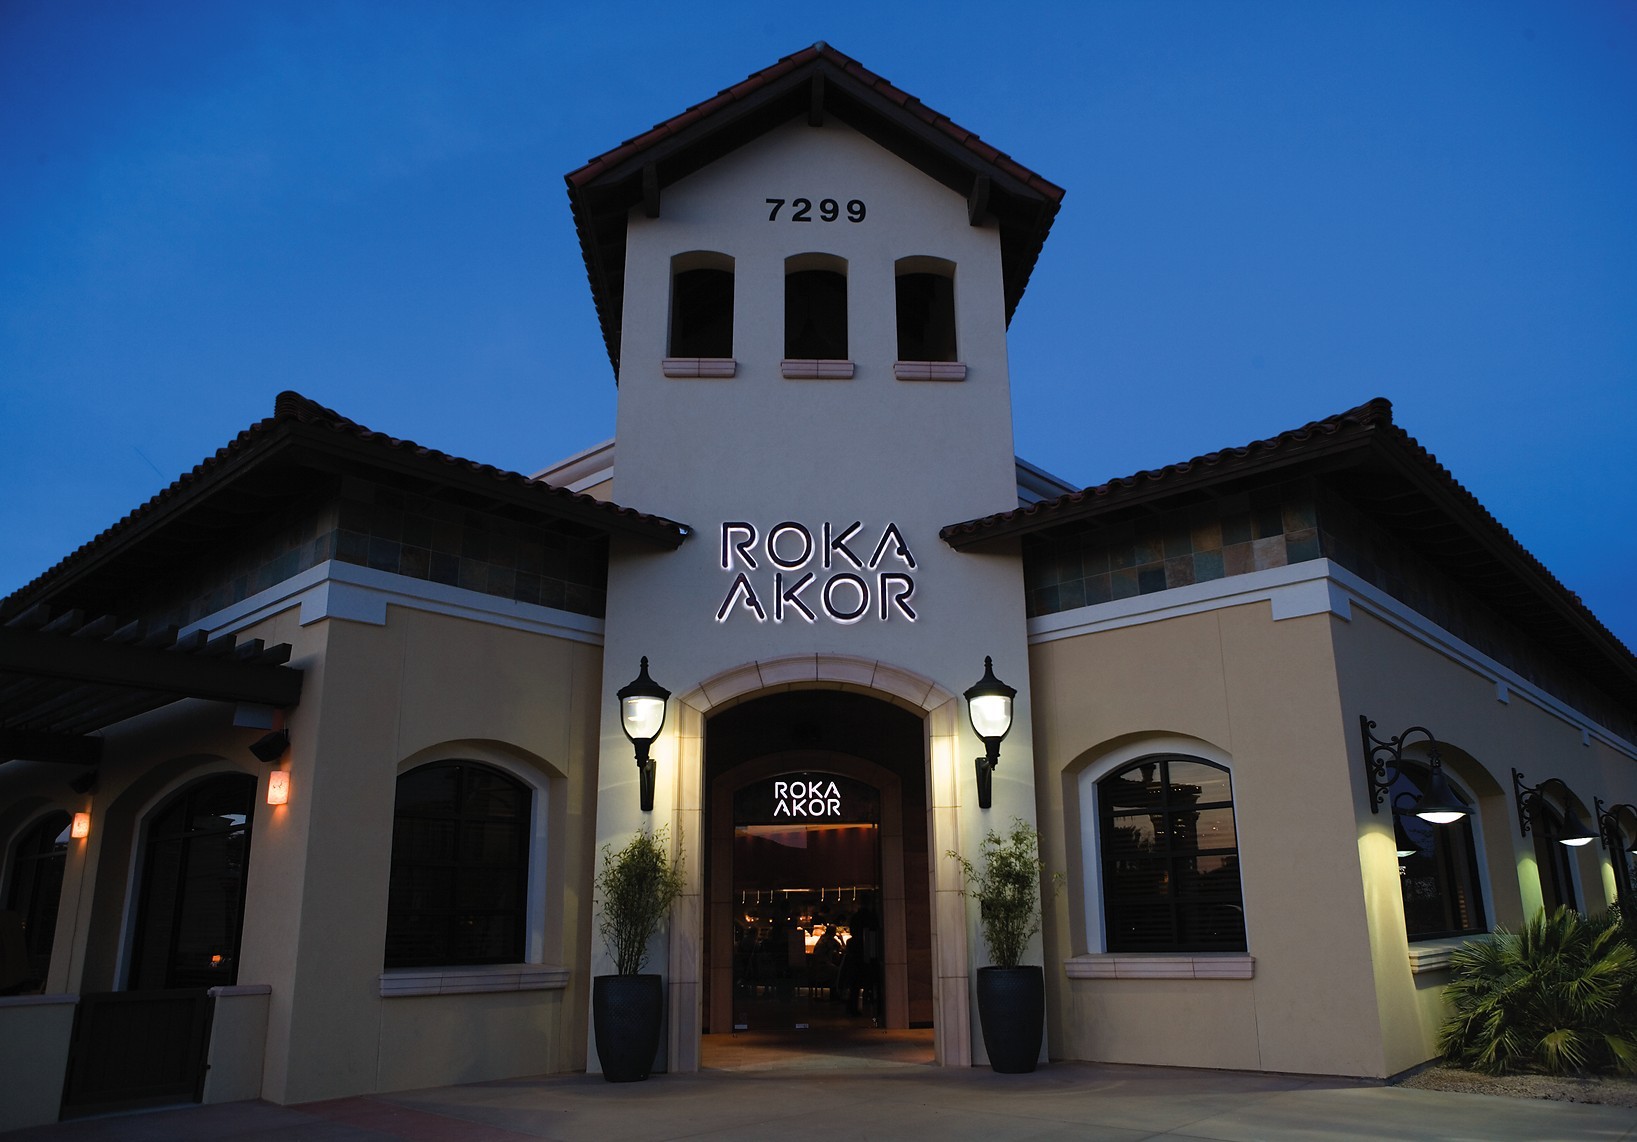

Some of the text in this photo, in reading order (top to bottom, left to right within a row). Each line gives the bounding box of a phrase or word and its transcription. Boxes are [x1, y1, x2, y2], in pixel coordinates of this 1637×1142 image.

[765, 197, 866, 223] 7299
[720, 520, 917, 570] ROKA
[715, 571, 917, 624] AKOR
[774, 781, 841, 799] ROKA
[773, 798, 841, 817] AKOR
